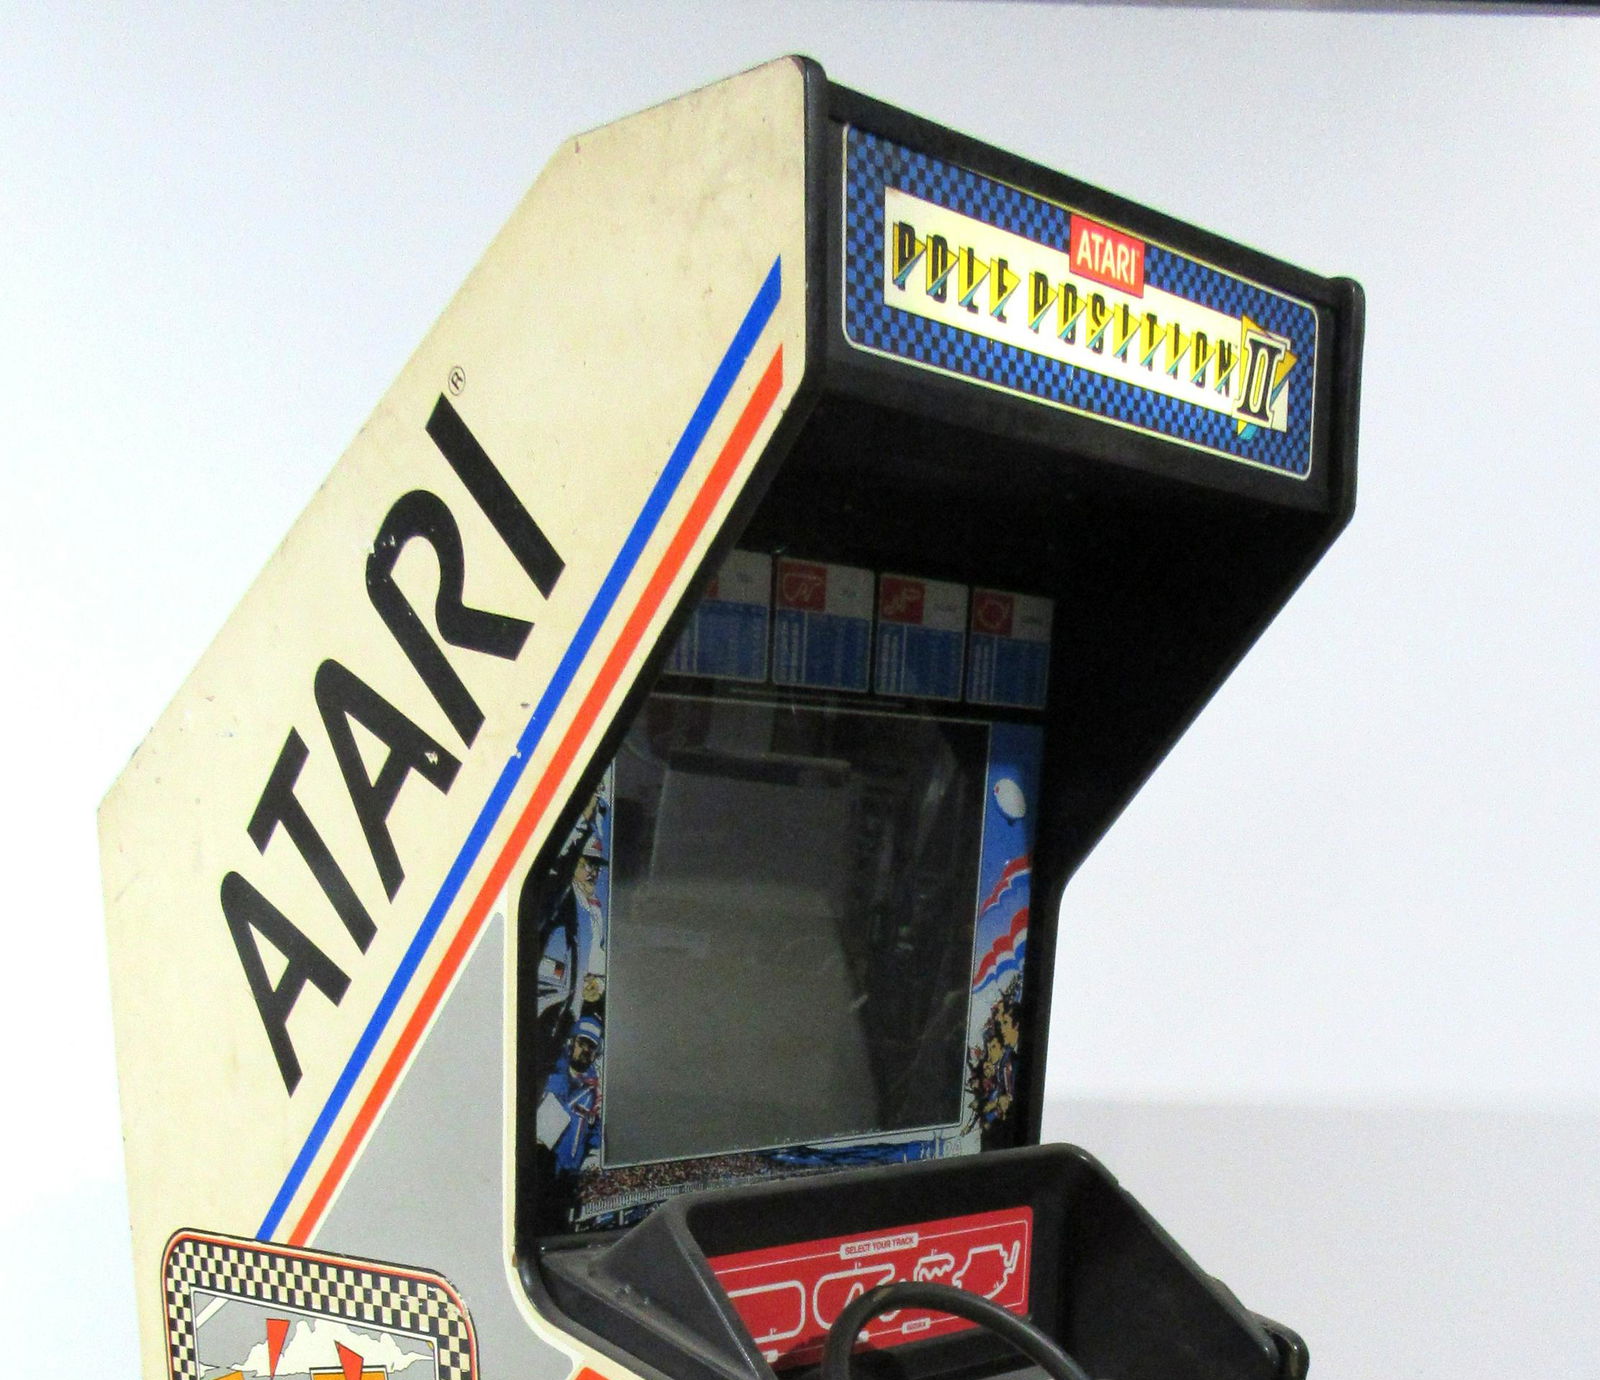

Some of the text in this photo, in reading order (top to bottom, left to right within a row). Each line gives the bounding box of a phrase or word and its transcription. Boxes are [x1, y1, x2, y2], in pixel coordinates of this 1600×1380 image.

[895, 220, 1016, 324] POLE
[1029, 270, 1233, 397] POSITION
[1077, 228, 1135, 286] ATARI
[220, 392, 566, 1098] ATARI
[845, 1236, 914, 1255] SELECT YOUR TRACK
